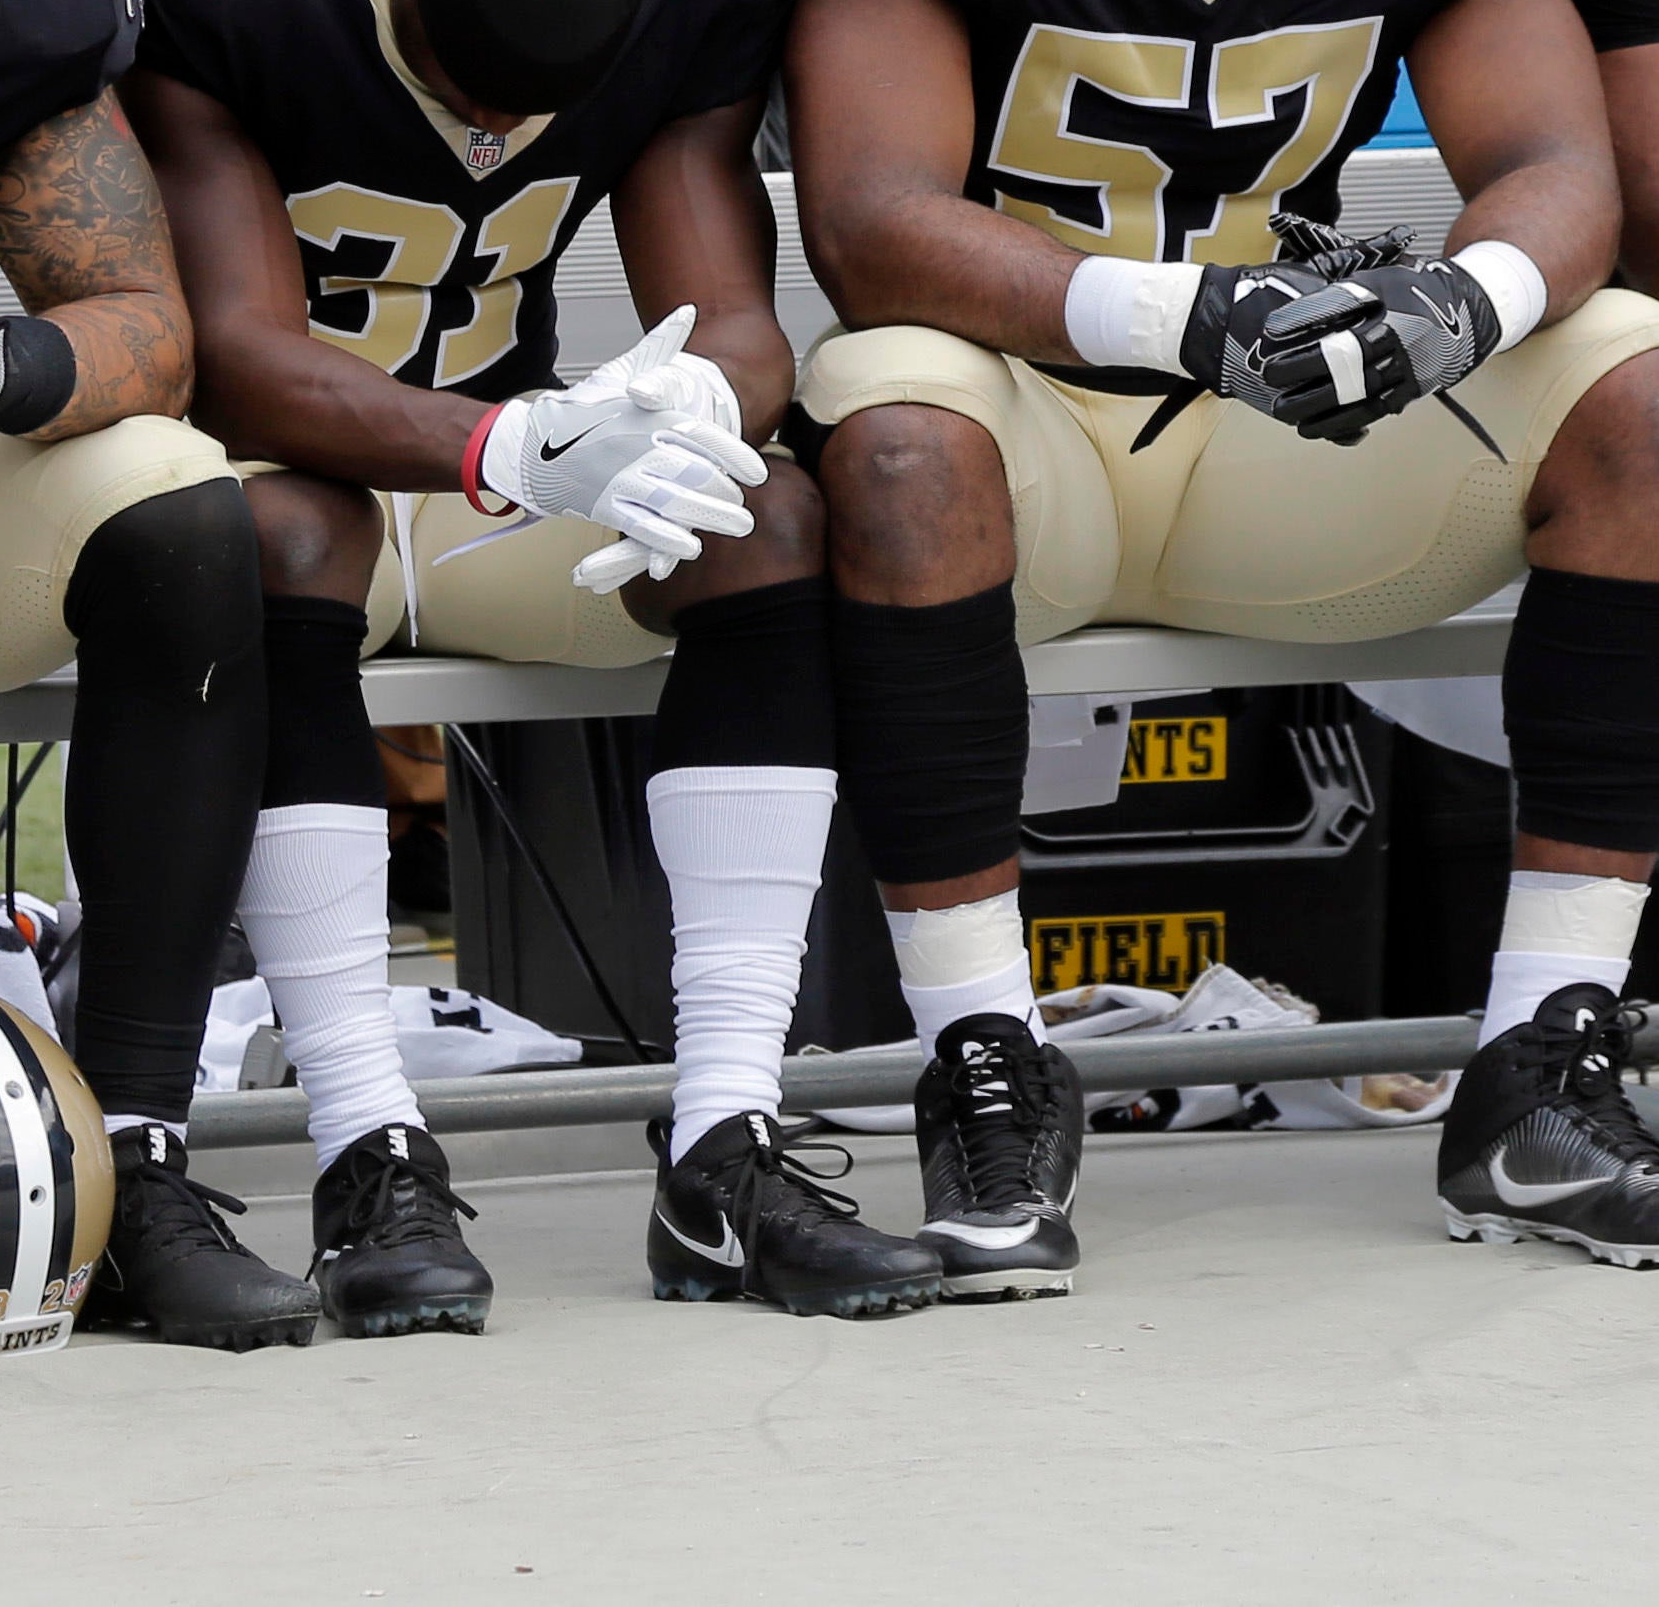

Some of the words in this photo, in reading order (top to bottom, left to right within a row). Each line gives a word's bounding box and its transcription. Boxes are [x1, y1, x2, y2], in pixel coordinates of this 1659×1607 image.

[470, 147, 501, 167] NFL
[986, 15, 1385, 264] 57
[285, 176, 581, 389] 31
[1122, 721, 1214, 779] NTS
[1035, 917, 1219, 995] FIELD
[148, 1127, 168, 1164] VPR
[40, 1278, 65, 1314] 2
